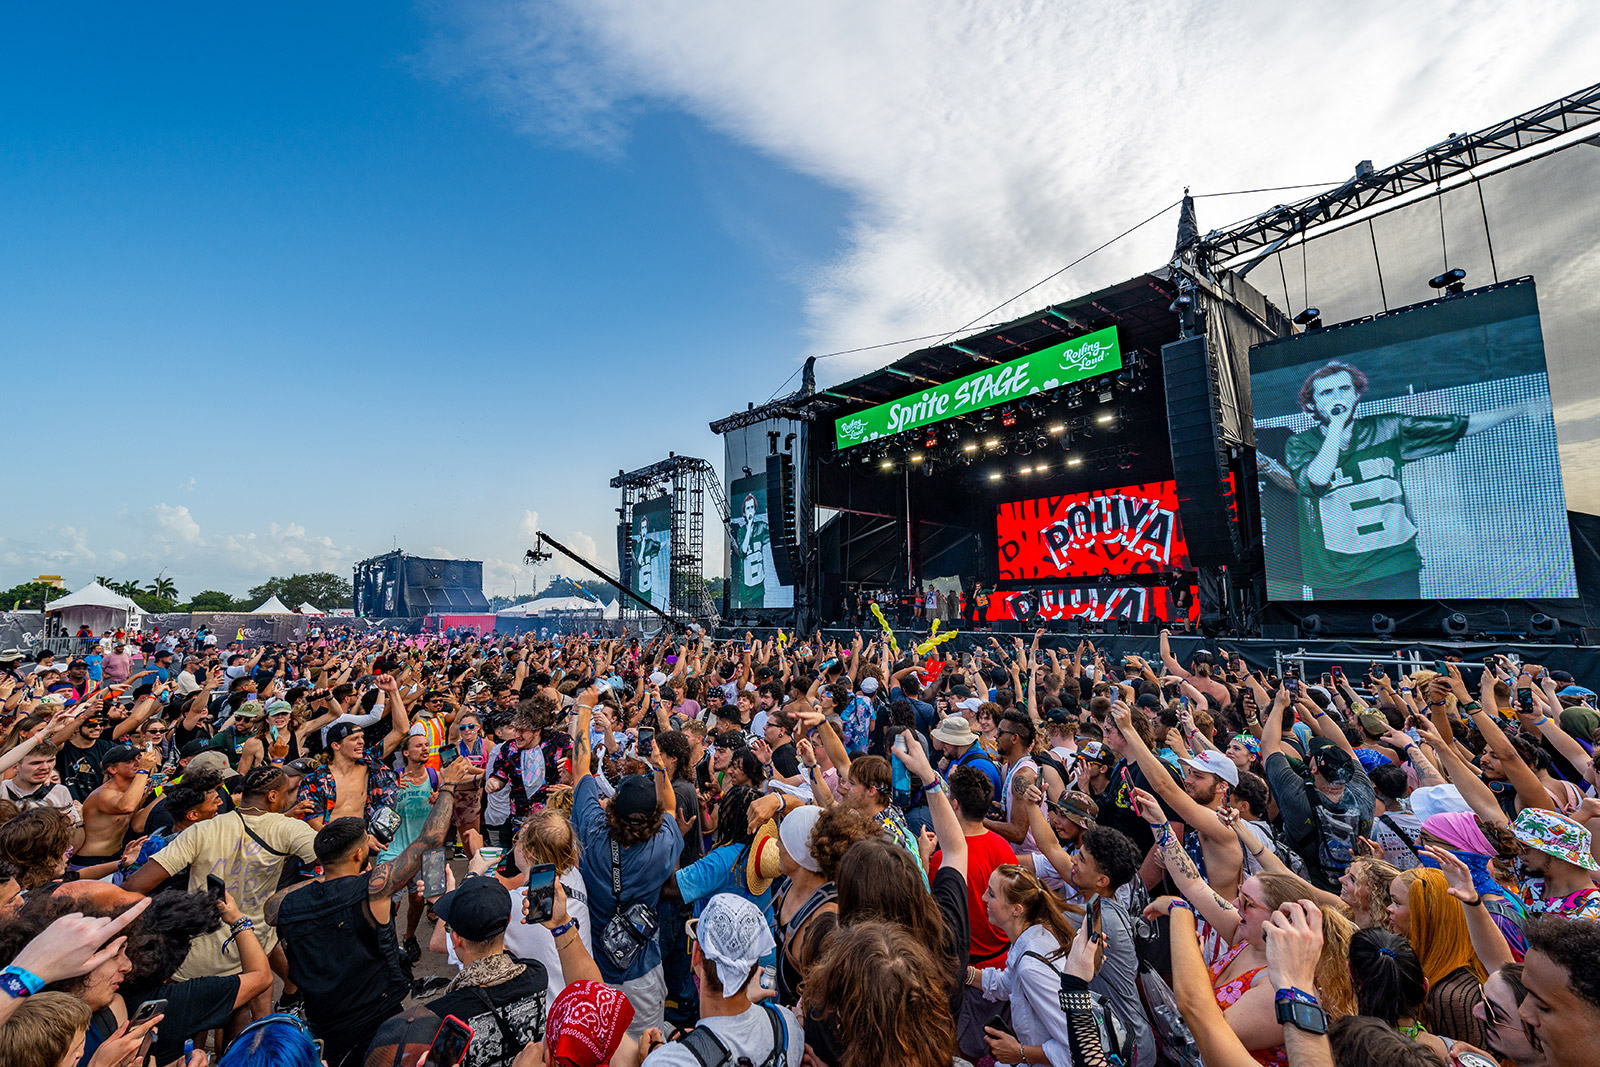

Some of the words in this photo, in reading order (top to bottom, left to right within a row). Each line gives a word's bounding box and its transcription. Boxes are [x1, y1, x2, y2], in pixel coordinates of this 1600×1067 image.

[1059, 350, 1105, 371] Loud
[1063, 341, 1114, 363] Rolling
[887, 391, 950, 433] Sprite
[954, 362, 1030, 410] STAGE
[839, 426, 864, 440] Loud
[841, 419, 869, 434] Rolling
[1040, 494, 1174, 570] POUYA
[639, 564, 652, 593] 6
[744, 551, 765, 587] 6
